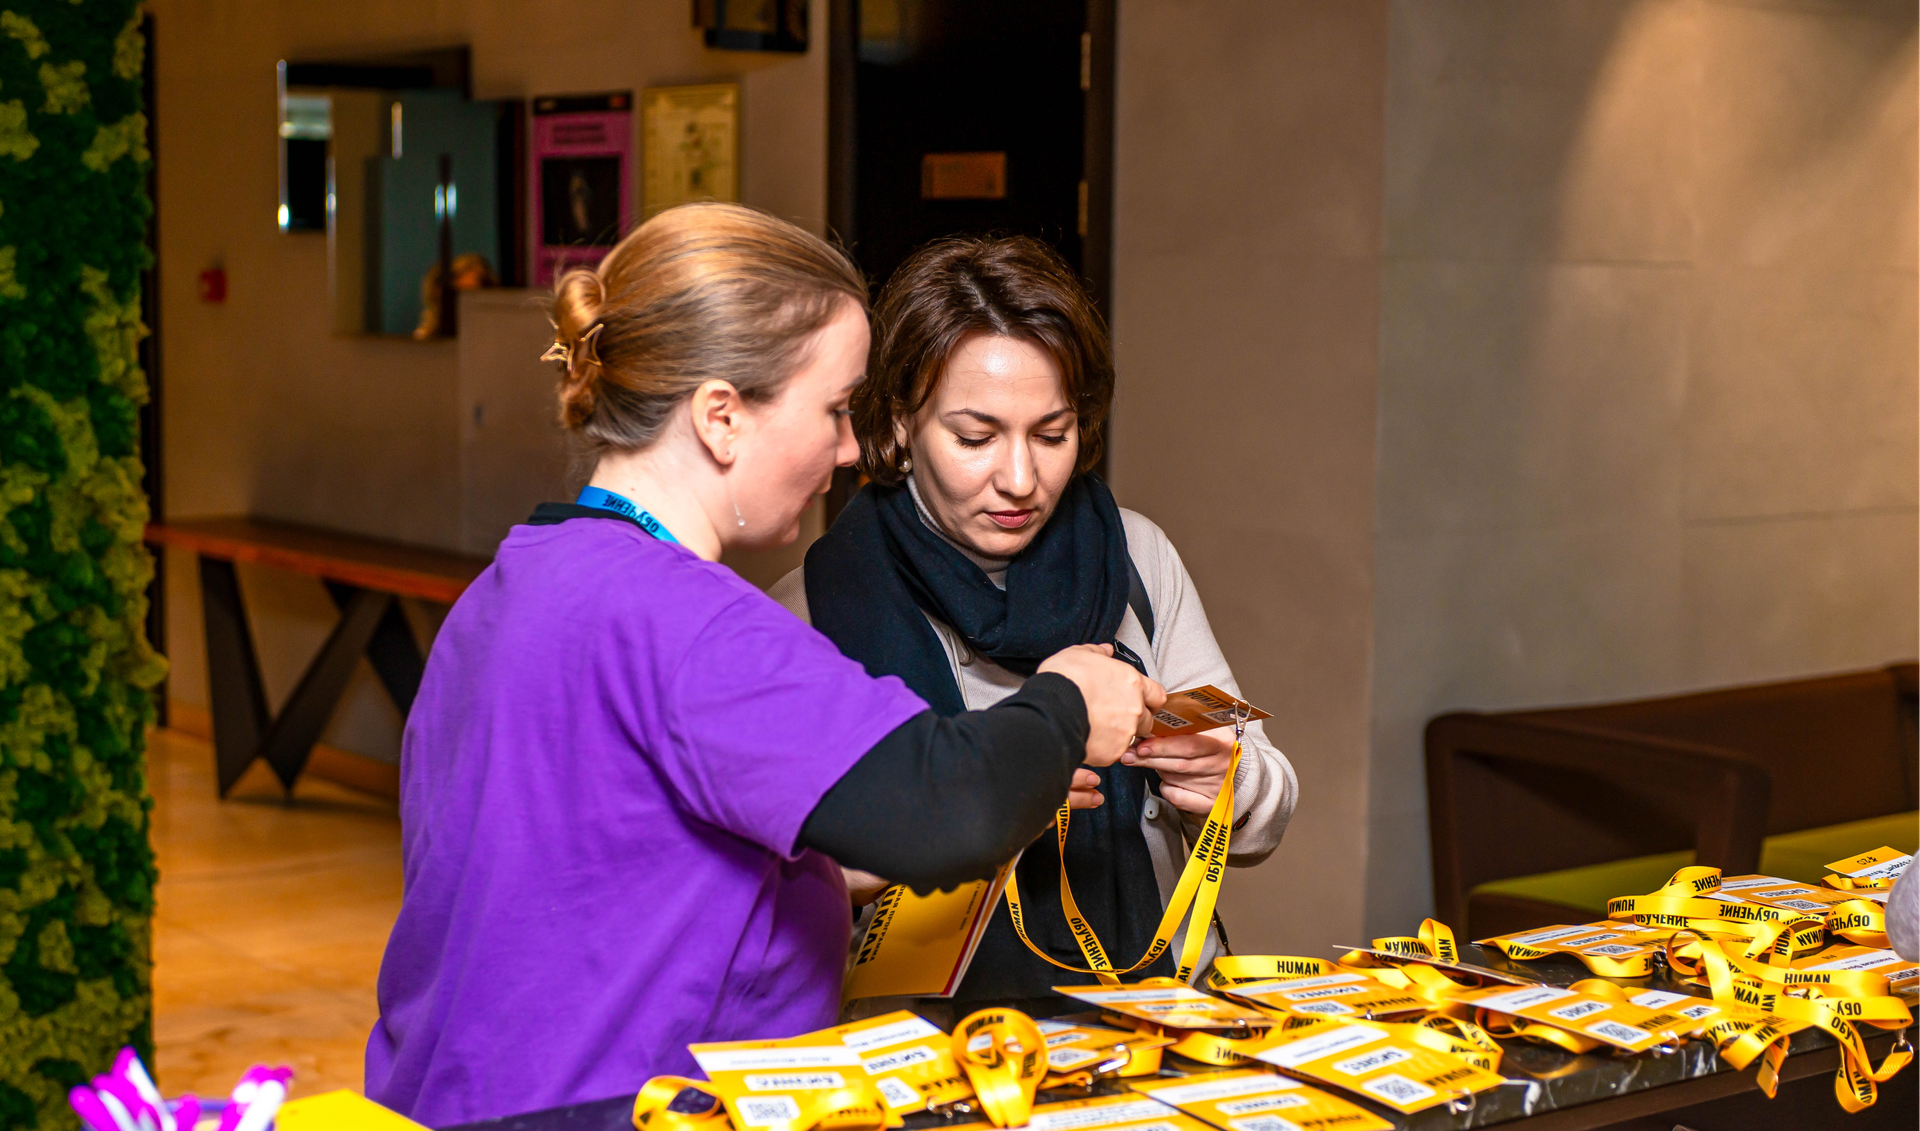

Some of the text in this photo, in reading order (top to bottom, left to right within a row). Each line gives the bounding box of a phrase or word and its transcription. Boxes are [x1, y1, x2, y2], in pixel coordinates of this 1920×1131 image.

[1195, 820, 1219, 862] HUMAN
[1206, 824, 1229, 883] ОБУЧЕНИЕ
[856, 888, 897, 966] UMAN
[1719, 904, 1779, 923] ОБУЧЕНИЕ
[870, 910, 896, 962] ПРОГРАММА
[1070, 917, 1107, 972] ОБУЧЕНИЕ
[1385, 941, 1427, 954] HUMAN
[1277, 960, 1320, 975] HUMAN
[1784, 973, 1831, 984] HUMAN
